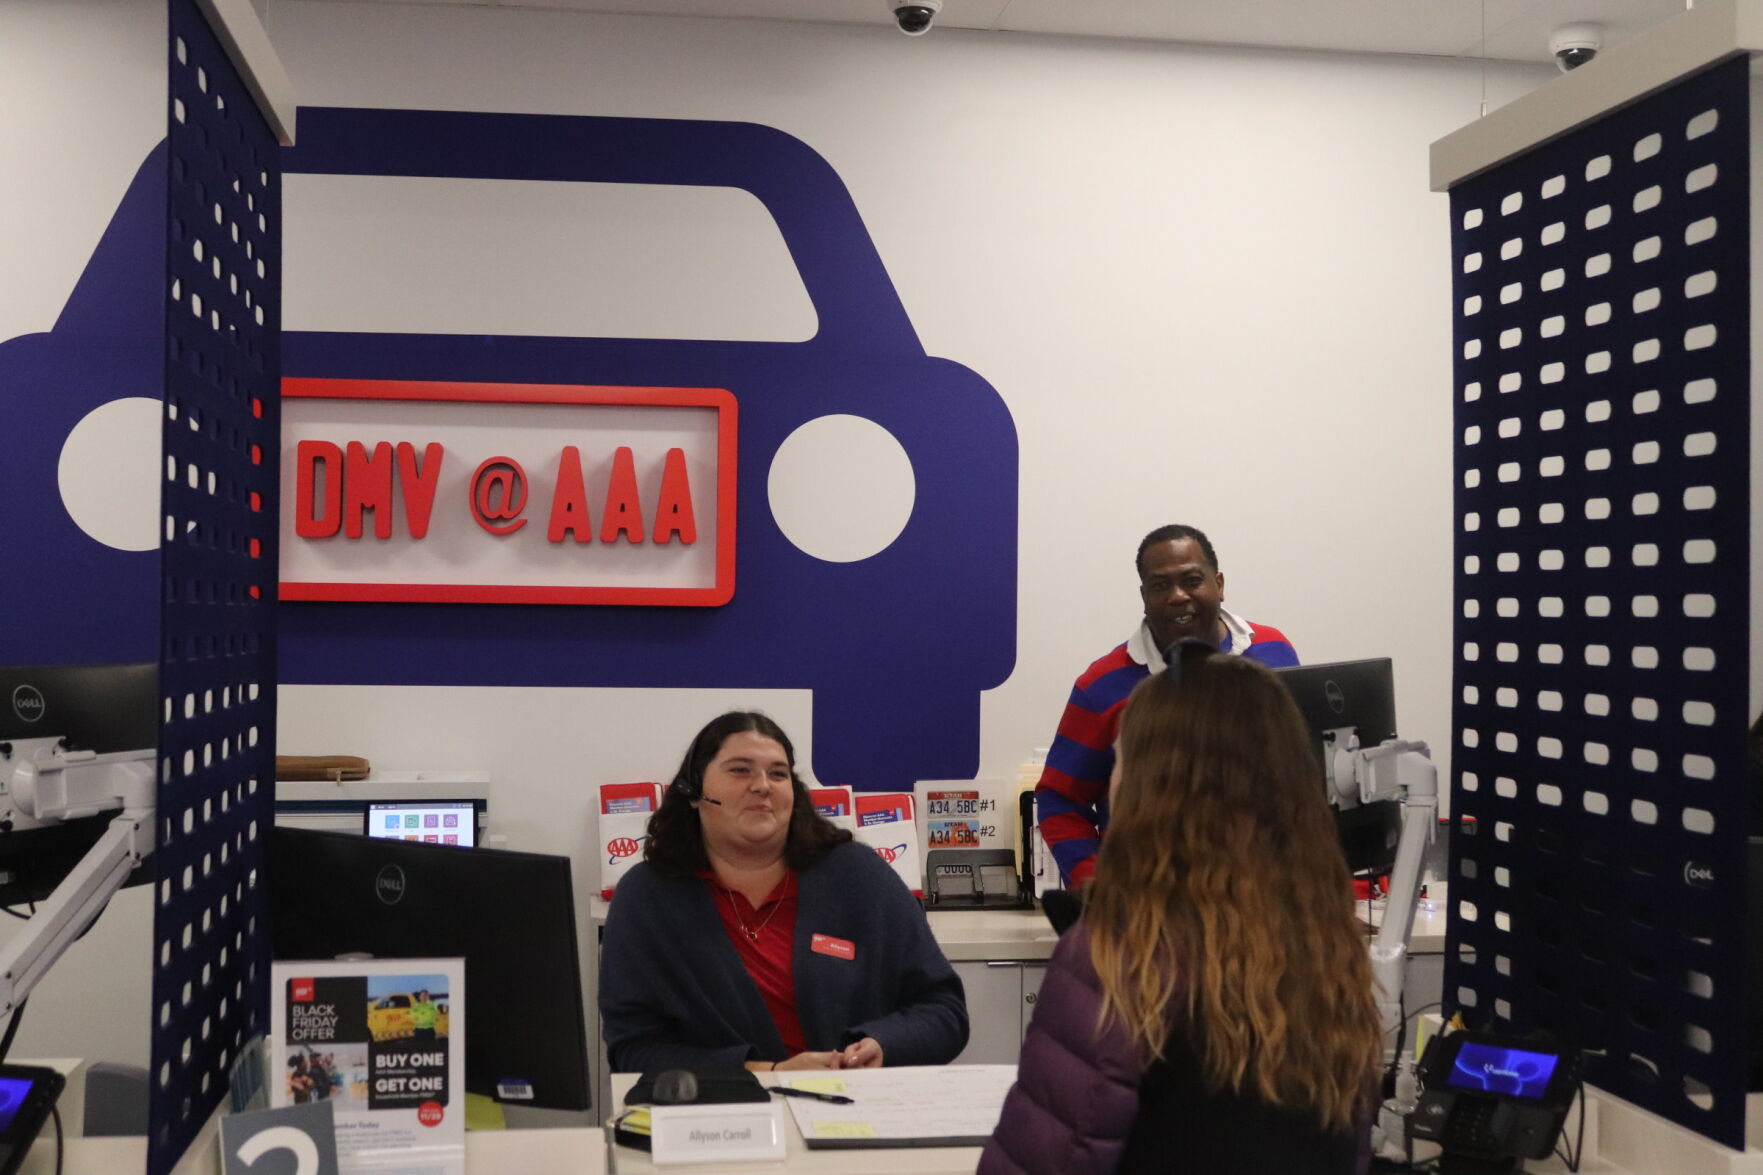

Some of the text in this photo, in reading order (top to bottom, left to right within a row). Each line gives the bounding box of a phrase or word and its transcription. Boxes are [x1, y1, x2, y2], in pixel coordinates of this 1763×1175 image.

[296, 440, 697, 545] DMV @ AAA
[929, 799, 996, 815] A34 5BC #1
[930, 825, 996, 845] A34 5BC #2
[608, 838, 638, 857] AAA
[292, 1004, 335, 1017] BLACK
[292, 1016, 338, 1029] FRIDAY
[292, 1028, 335, 1040] OFFER
[375, 1052, 444, 1068] BUY ONE
[375, 1076, 443, 1093] GET ONE
